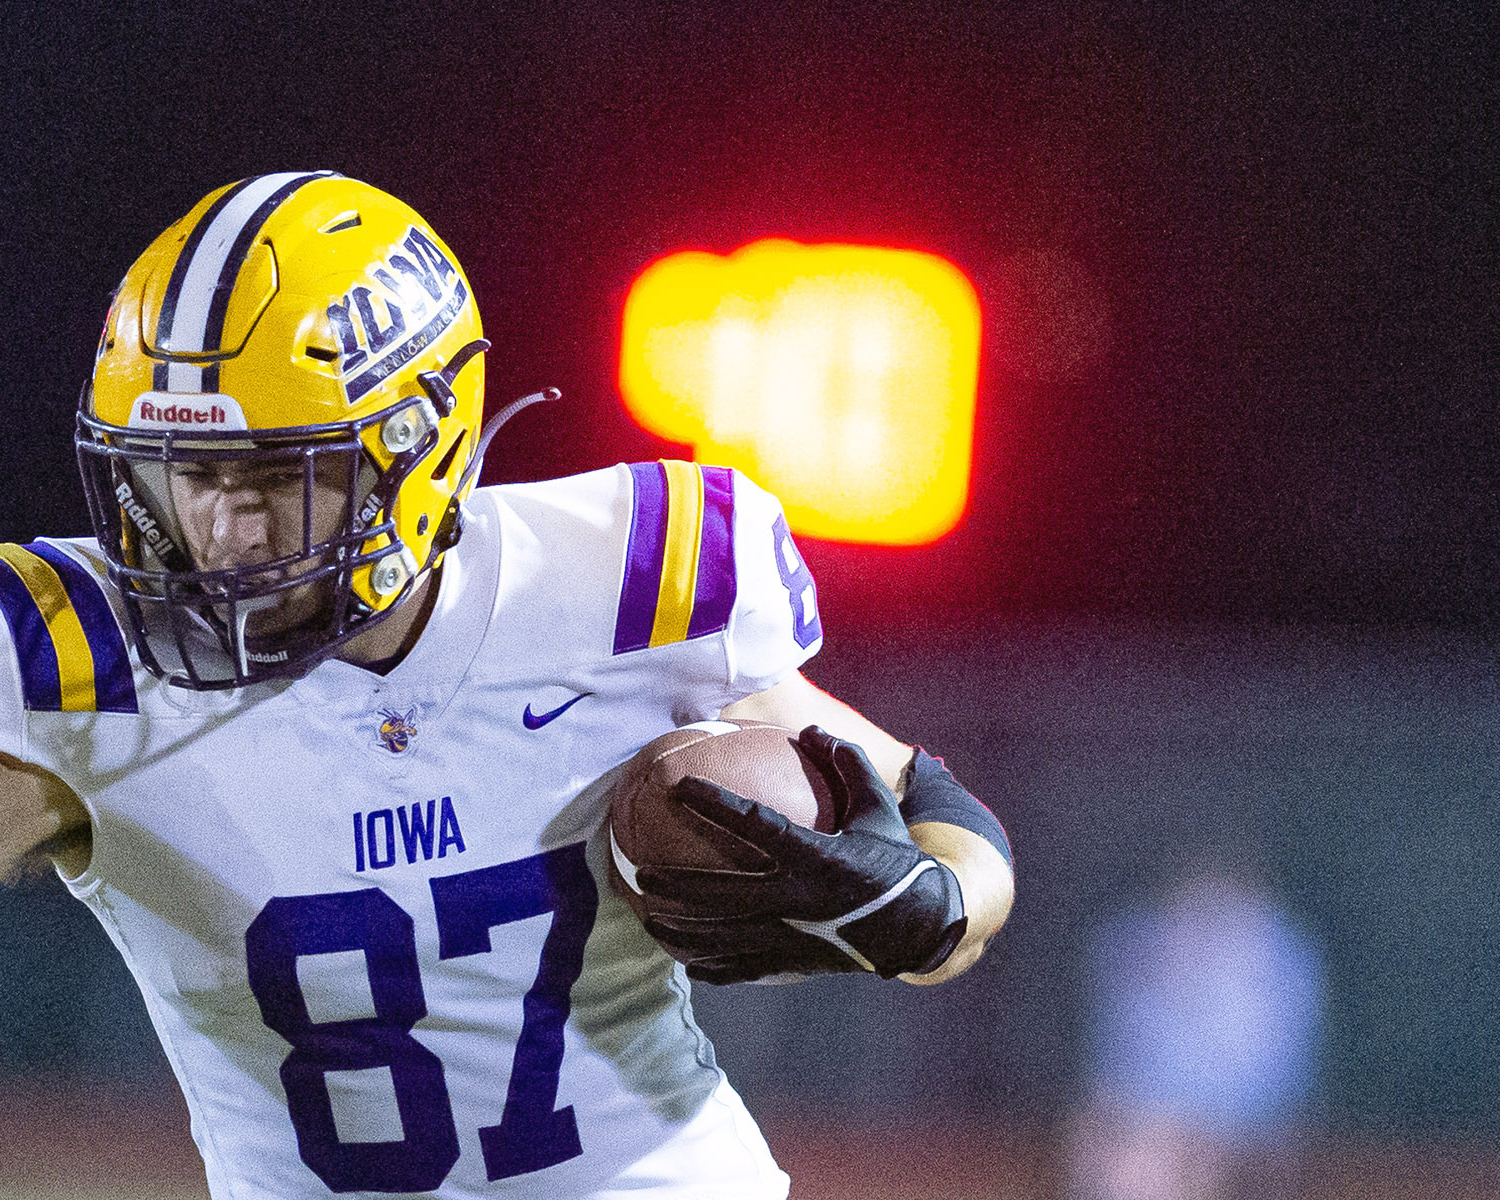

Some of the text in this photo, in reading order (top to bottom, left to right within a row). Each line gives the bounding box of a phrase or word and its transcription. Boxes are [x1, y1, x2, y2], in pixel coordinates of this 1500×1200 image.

[325, 226, 456, 374] IOWA
[140, 402, 226, 424] Riddell
[115, 481, 176, 557] Riddell
[352, 796, 467, 873] IOWA
[245, 840, 601, 1194] 87
